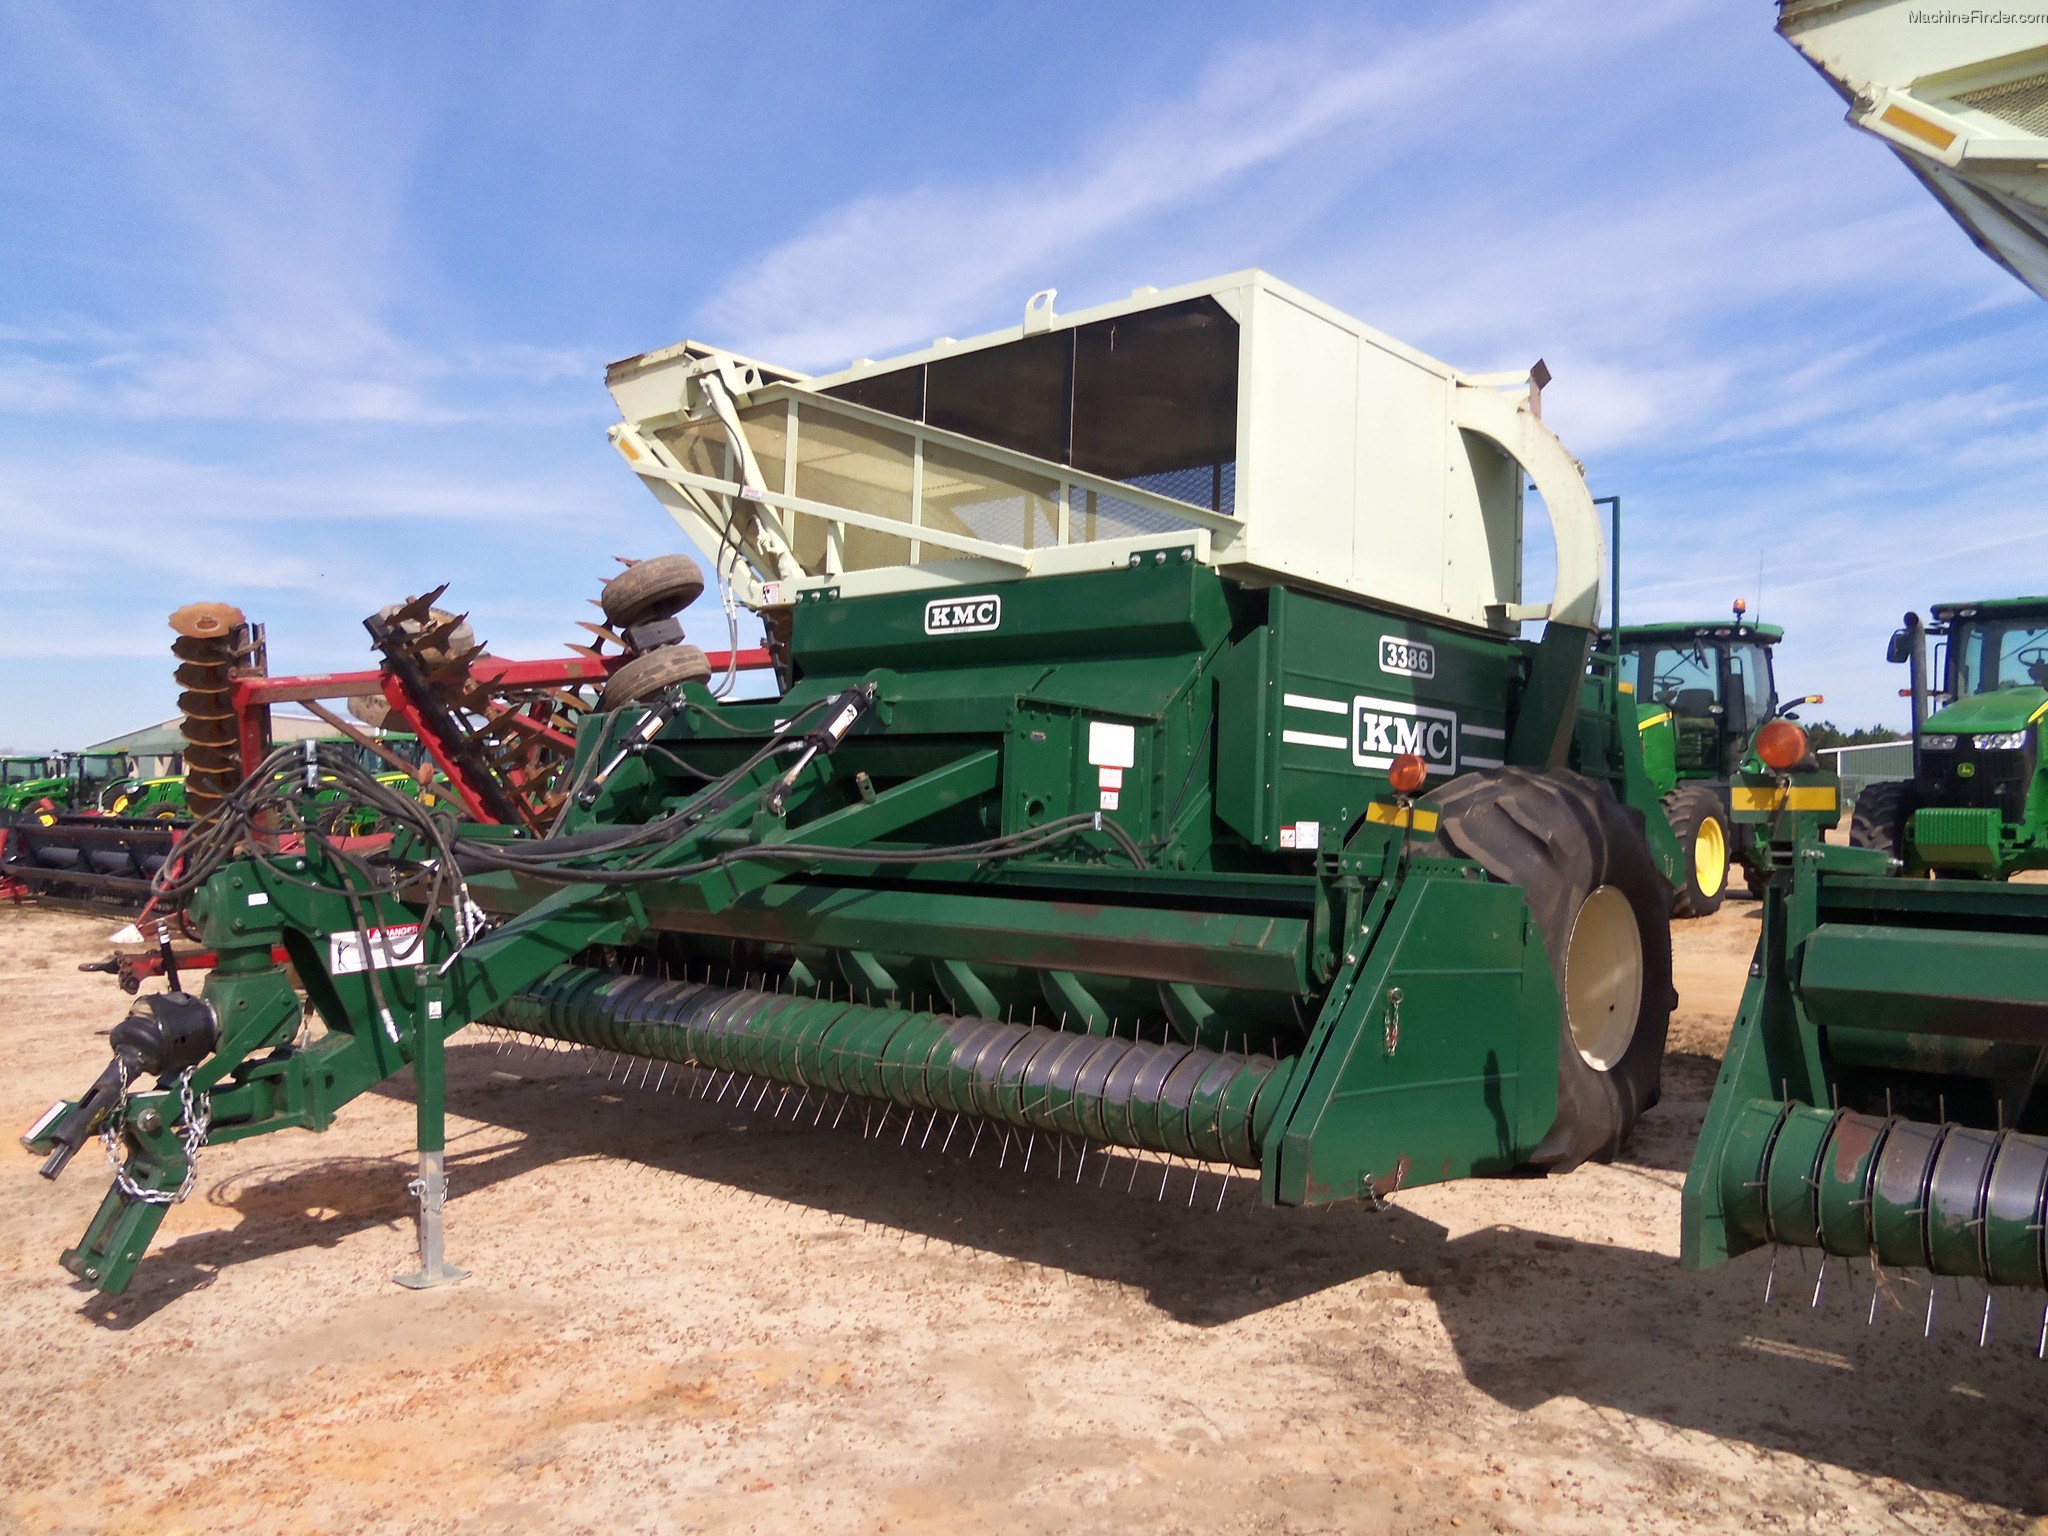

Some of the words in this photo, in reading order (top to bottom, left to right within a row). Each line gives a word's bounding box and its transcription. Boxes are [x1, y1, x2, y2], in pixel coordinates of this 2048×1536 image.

[931, 602, 994, 627] KMC
[1387, 643, 1428, 672] 3386
[1363, 712, 1449, 760] KMC
